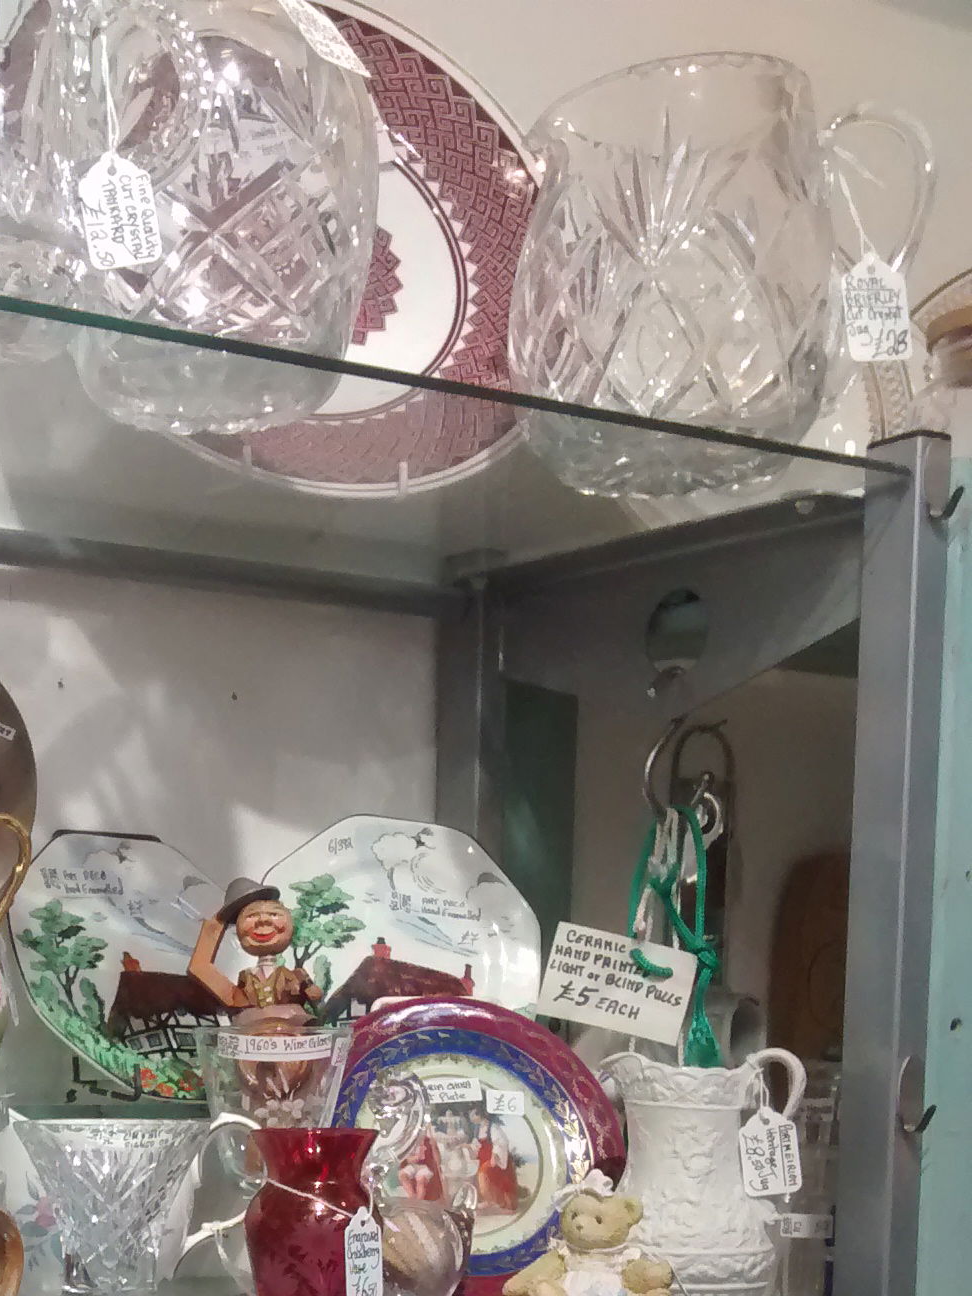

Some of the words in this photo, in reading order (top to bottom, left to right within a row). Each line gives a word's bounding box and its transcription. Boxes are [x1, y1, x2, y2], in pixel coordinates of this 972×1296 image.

[119, 174, 135, 200] CUT
[555, 944, 591, 962] HAND
[566, 929, 627, 954] CERAMIC
[549, 959, 585, 977] LIGHT
[587, 971, 601, 982] or
[605, 973, 644, 993] BLIND
[645, 985, 683, 1007] PULLS
[553, 980, 600, 1007] £5
[595, 997, 641, 1020] EACH
[493, 1093, 517, 1112] £6
